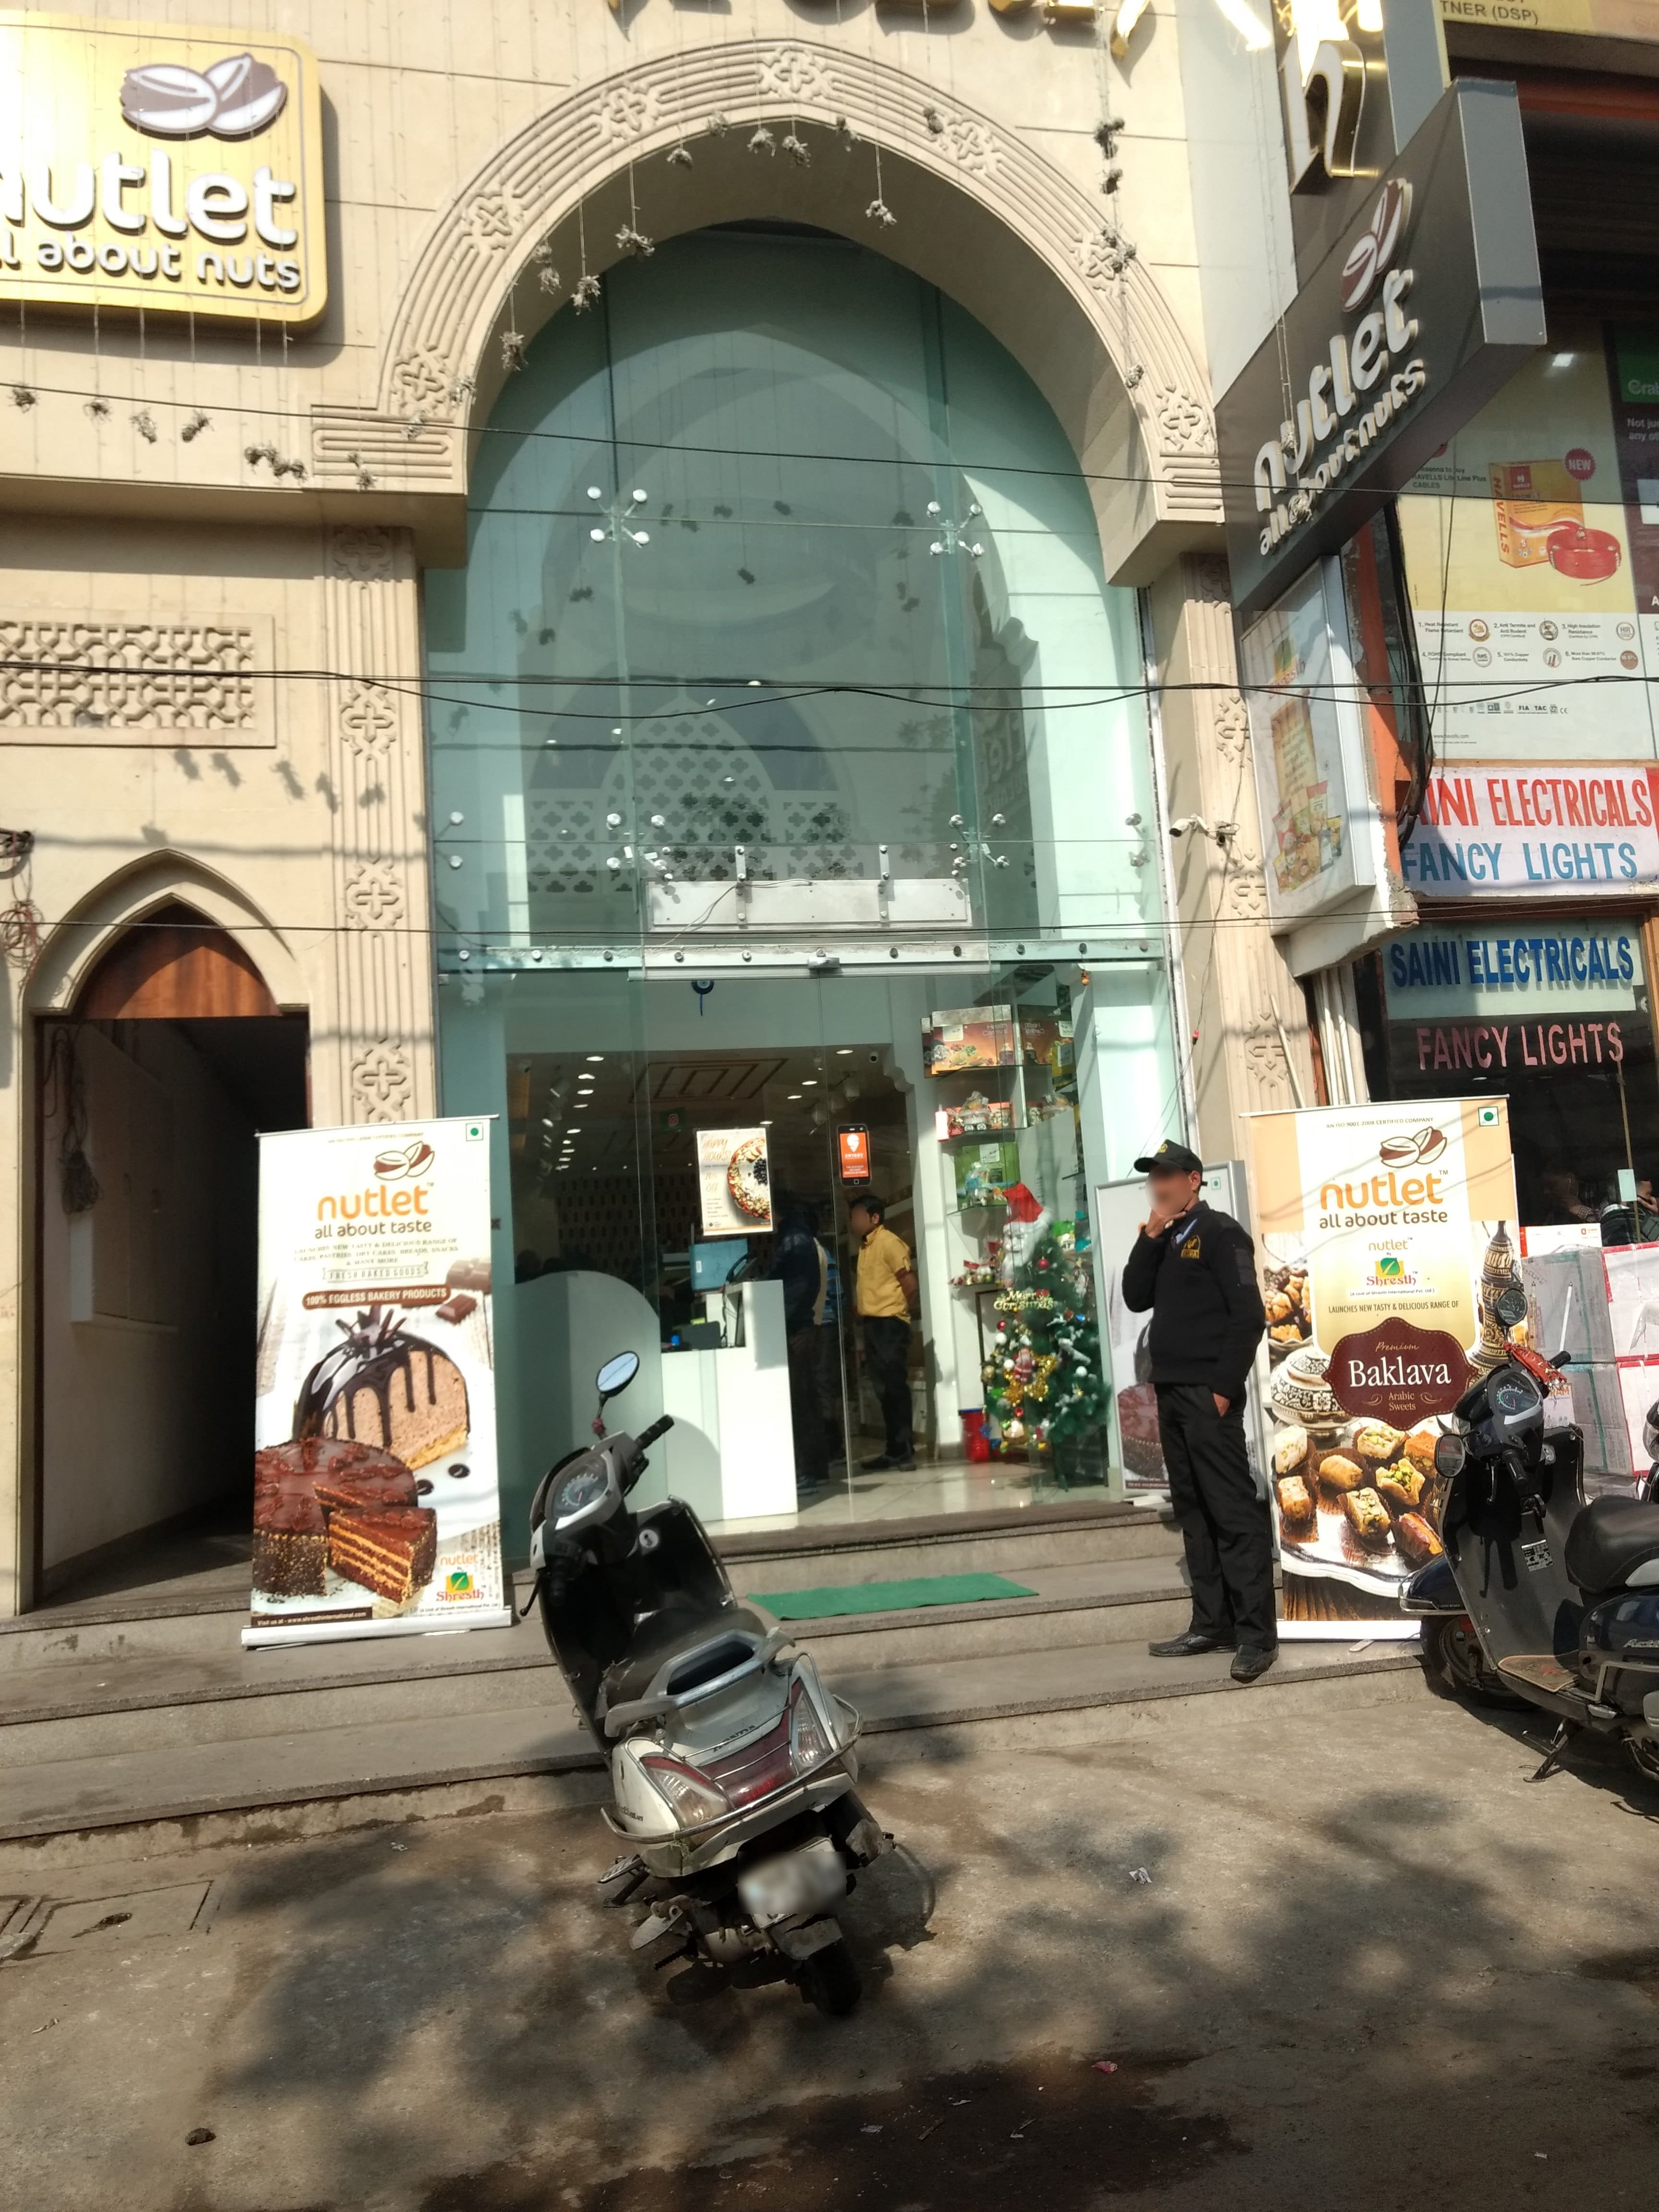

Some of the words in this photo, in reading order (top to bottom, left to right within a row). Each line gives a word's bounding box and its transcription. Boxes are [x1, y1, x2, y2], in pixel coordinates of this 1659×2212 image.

[1491, 5, 1539, 25] (DSP)
[37, 231, 181, 277] about
[197, 252, 300, 290] nuts
[1254, 268, 1419, 512] nutlet
[1259, 504, 1291, 556] all
[1359, 359, 1425, 448] nuts
[1568, 459, 1592, 472] NEW
[1493, 477, 1510, 553] HAVELLS
[1416, 779, 1479, 826] INI
[1487, 779, 1653, 828] ELECTRICALS
[1402, 842, 1502, 881] FANCY
[1523, 842, 1637, 880] LIGHTS
[1392, 941, 1461, 987] SAINI
[1468, 936, 1634, 985] ELECTRICALS
[1416, 1025, 1510, 1071] FANCY
[1521, 1022, 1625, 1066] LIGHTS
[1320, 1171, 1443, 1210] nutlet
[317, 1185, 429, 1221] nutlet
[1319, 1214, 1340, 1229] all
[1345, 1210, 1398, 1228] about
[1403, 1209, 1448, 1226] taste
[314, 1225, 333, 1240] all
[337, 1222, 385, 1237] about
[391, 1220, 432, 1234] taste
[382, 1240, 421, 1248] DELICIOUS
[1369, 1239, 1408, 1251] nutlet
[1366, 1274, 1416, 1286] Shresth
[306, 1296, 327, 1306] 100%
[329, 1293, 366, 1304] EGGLESS
[368, 1290, 401, 1301] BAKERY
[403, 1288, 447, 1299] PRODUCTS
[1329, 1305, 1358, 1313] LAUNCHES
[1399, 1302, 1429, 1310] DELICIOUS
[1375, 1342, 1419, 1352] Premium
[1348, 1356, 1452, 1387] Baklava
[1388, 1391, 1415, 1401] Arabic
[1389, 1401, 1416, 1411] Sweets
[440, 1552, 479, 1566] nutlet
[436, 1589, 484, 1603] Shresth
